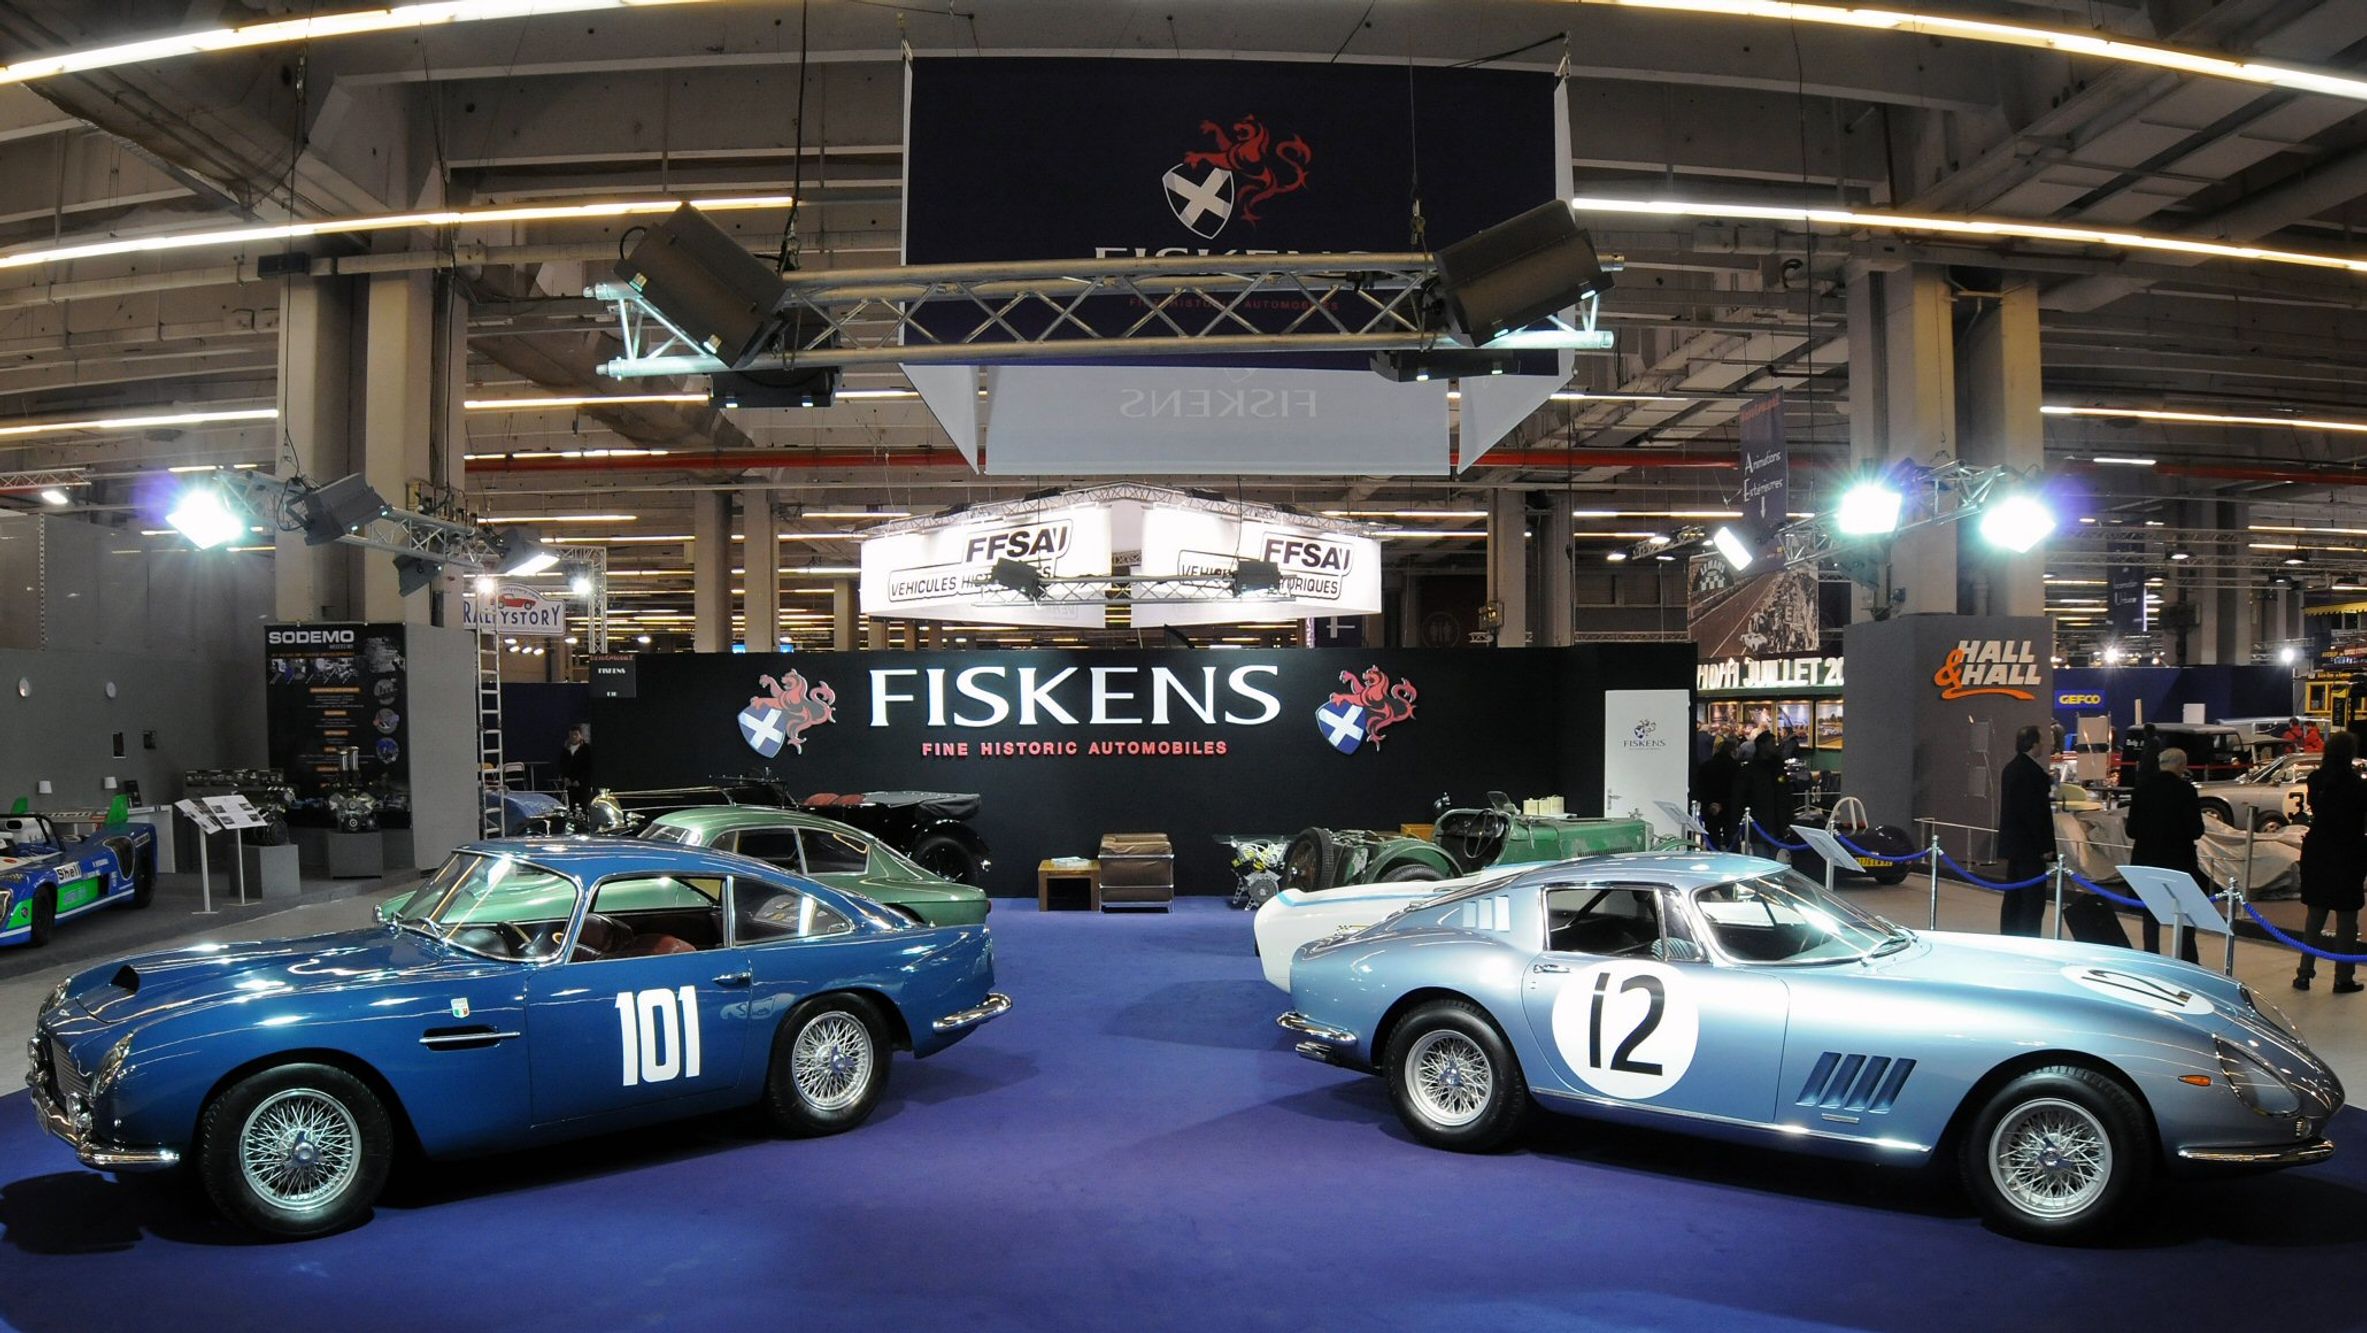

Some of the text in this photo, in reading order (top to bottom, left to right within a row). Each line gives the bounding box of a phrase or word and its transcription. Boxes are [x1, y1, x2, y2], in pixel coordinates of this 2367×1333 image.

[891, 576, 957, 597] VEHICULES
[268, 629, 355, 644] SODEMO
[1957, 640, 2035, 663] HALL
[1743, 656, 1822, 688] JUILLET
[1961, 664, 2042, 685] HALL
[869, 664, 1281, 728] FISKENS
[2059, 694, 2101, 704] GEFCO
[921, 740, 1228, 756] FINE HISTORIC AUTOMOBILES
[57, 864, 79, 880] Shell
[1589, 972, 1665, 1076] 12
[614, 985, 701, 1086] 101
